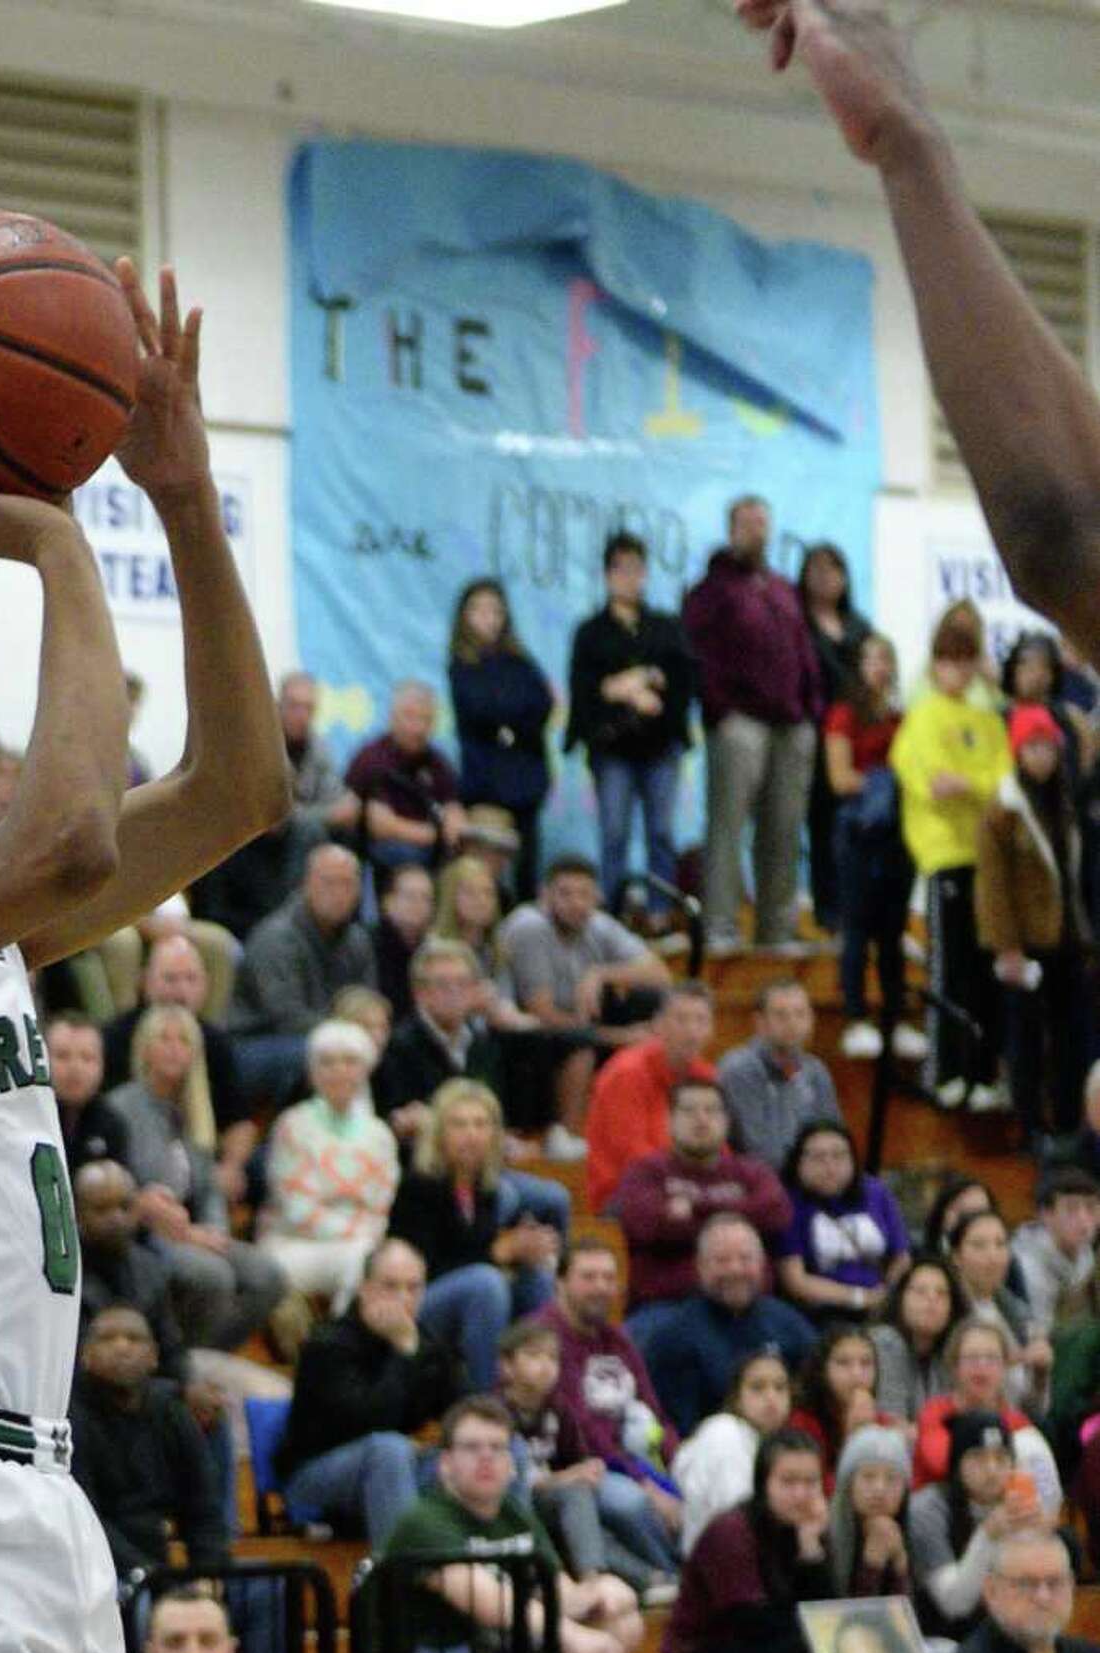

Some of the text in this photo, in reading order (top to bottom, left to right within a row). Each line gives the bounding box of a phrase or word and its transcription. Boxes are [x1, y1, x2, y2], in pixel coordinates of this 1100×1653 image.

[312, 290, 493, 396] THE
[101, 553, 176, 599] TEA
[30, 1142, 79, 1296] 0
